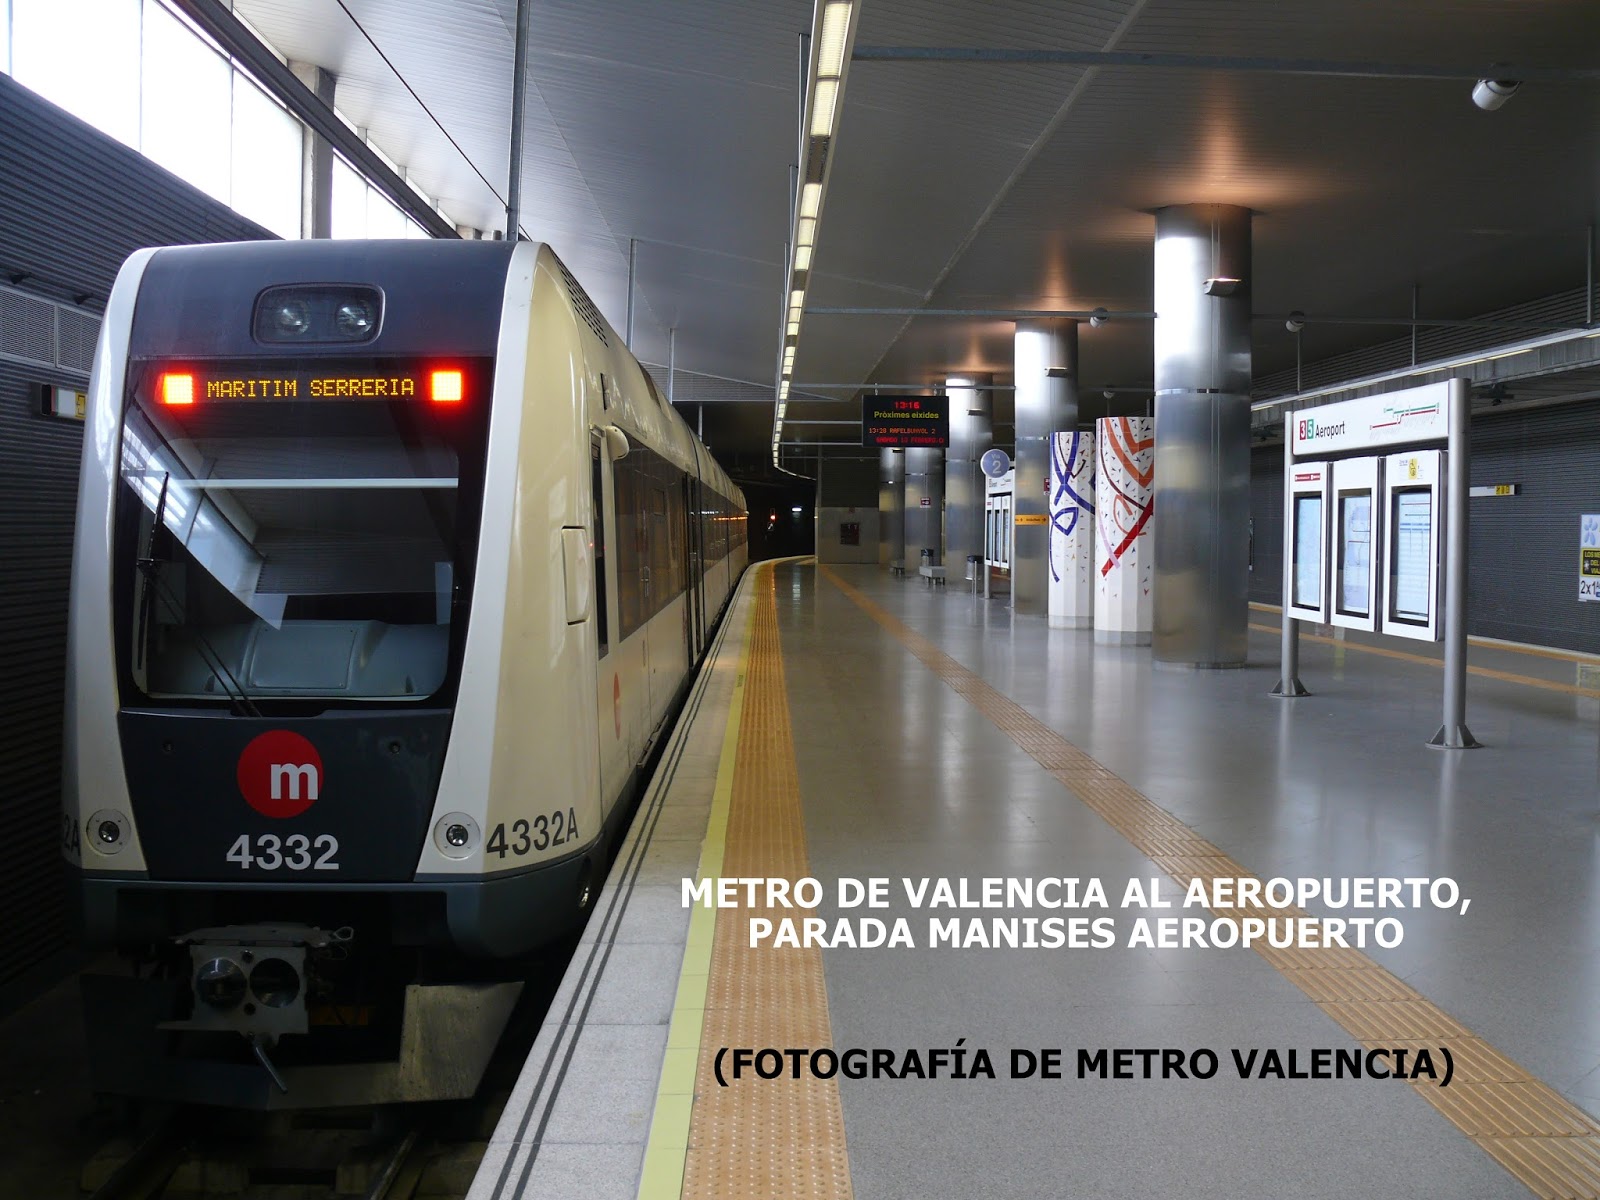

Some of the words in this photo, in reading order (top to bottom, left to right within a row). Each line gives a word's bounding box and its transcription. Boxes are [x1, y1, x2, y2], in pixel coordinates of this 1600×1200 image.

[207, 379, 297, 398] MARITIM
[310, 378, 415, 397] SERRERIA
[895, 401, 920, 409] 13:16
[911, 411, 939, 419] eixides
[1300, 420, 1306, 440] 3
[1307, 419, 1314, 439] 5
[1315, 421, 1345, 439] Aeroport
[992, 460, 1002, 474] 2
[1580, 580, 1596, 595] 2x1
[270, 763, 319, 800] m
[486, 806, 579, 859] 4332A
[226, 833, 340, 870] 4332
